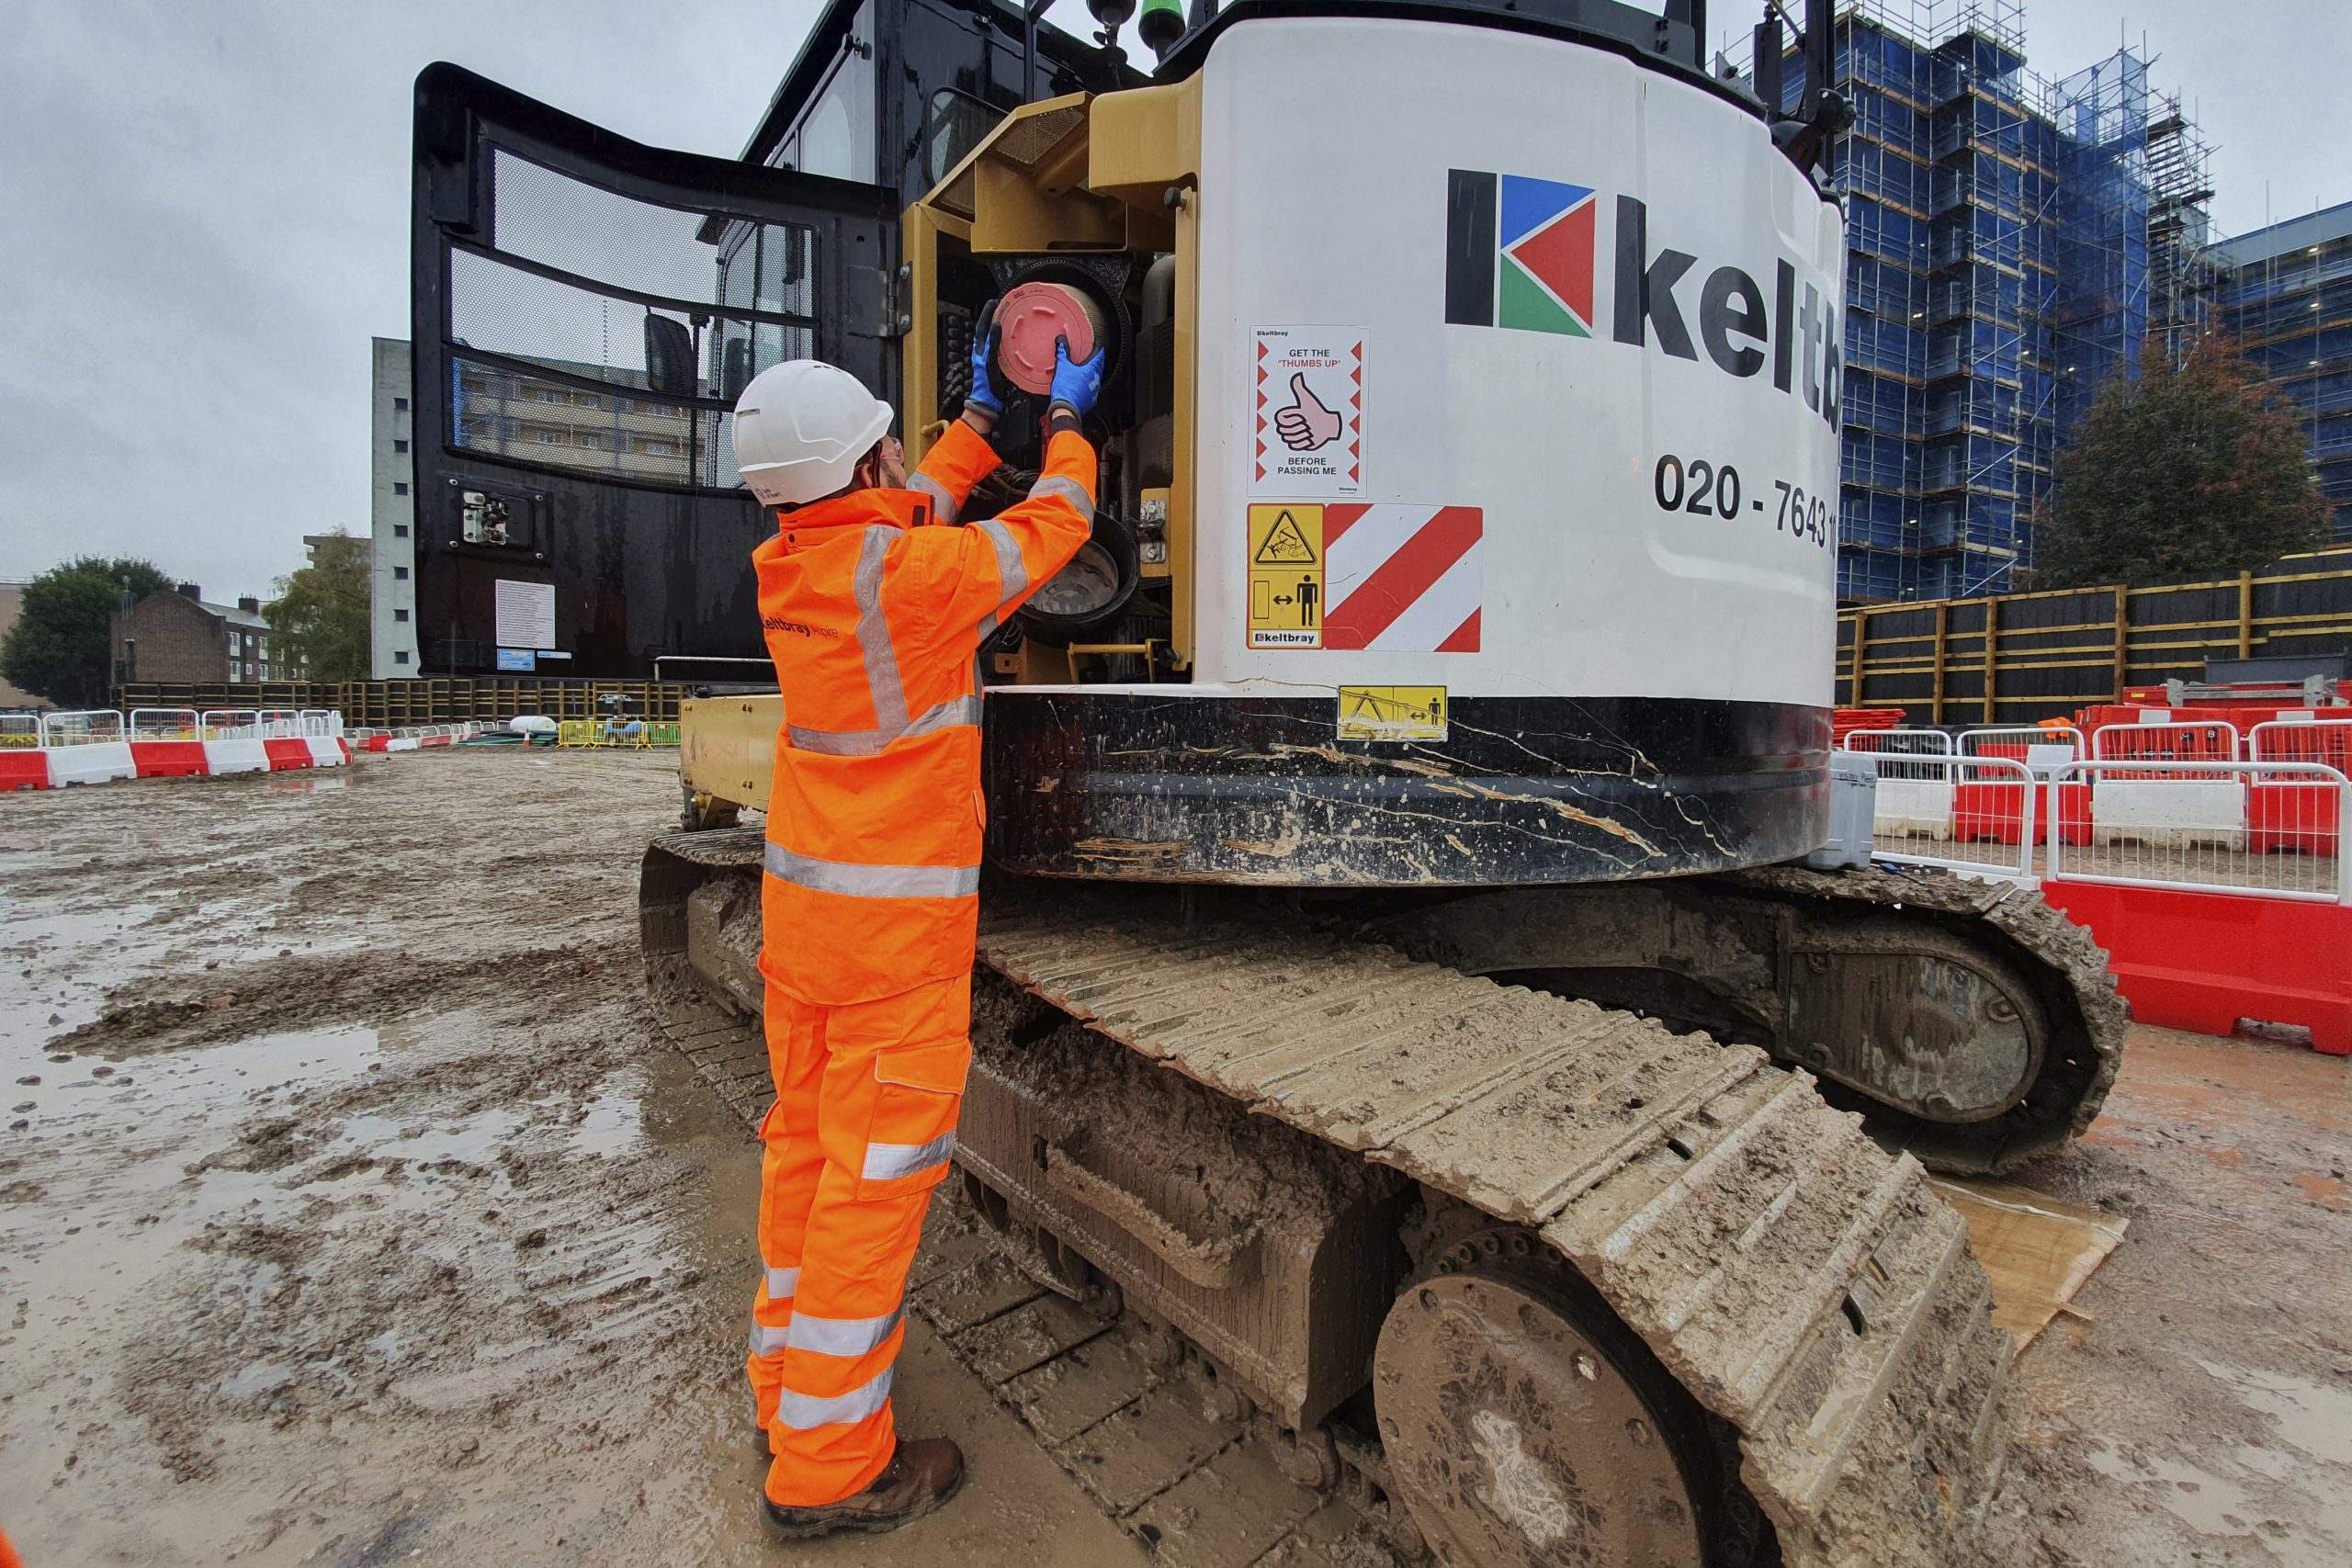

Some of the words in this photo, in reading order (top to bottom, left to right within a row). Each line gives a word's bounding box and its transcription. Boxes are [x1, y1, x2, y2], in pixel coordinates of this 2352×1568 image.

[1289, 349, 1308, 357] GET
[1311, 349, 1330, 357] THE
[1288, 457, 1327, 466] BEFORE
[1277, 467, 1320, 475] PASSING
[1322, 467, 1337, 475] ME
[1655, 455, 1741, 520] 020
[1774, 479, 1826, 547] 7643
[1264, 633, 1315, 644] keltbray
